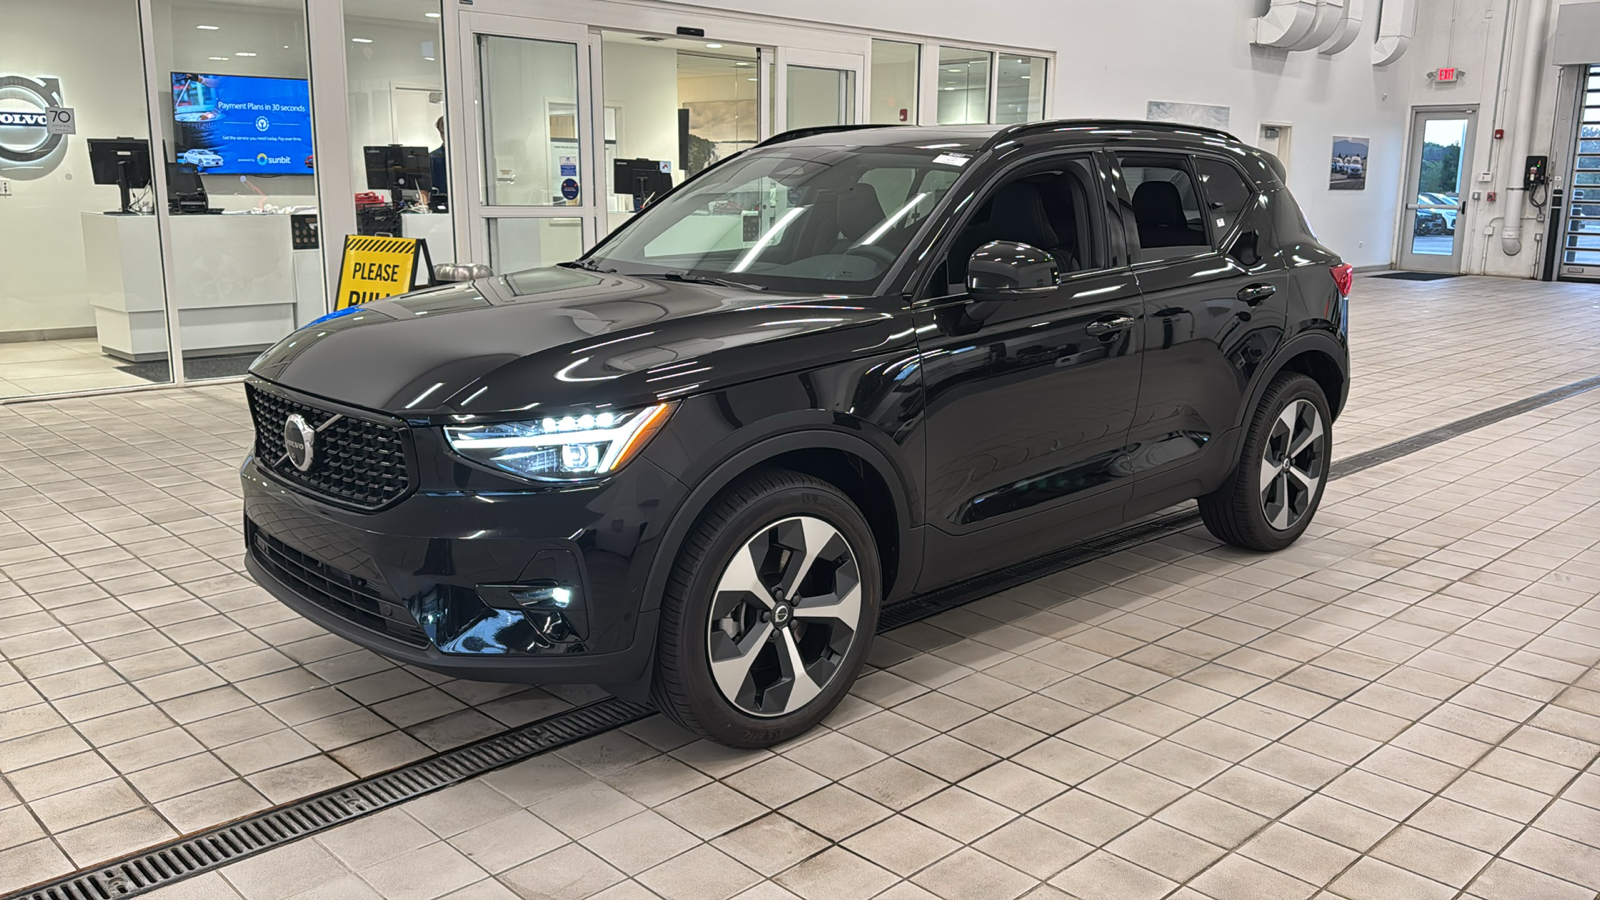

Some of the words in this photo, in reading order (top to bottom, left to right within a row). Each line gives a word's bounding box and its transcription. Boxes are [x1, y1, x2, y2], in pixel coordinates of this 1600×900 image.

[1438, 67, 1455, 80] EXIT
[218, 101, 246, 111] Payment
[247, 102, 264, 111] Plans
[265, 103, 271, 111] in
[272, 103, 280, 111] 30
[0, 113, 47, 125] OLVO
[49, 110, 71, 123] 70
[268, 156, 291, 164] sunbit
[352, 262, 399, 282] PLEASE
